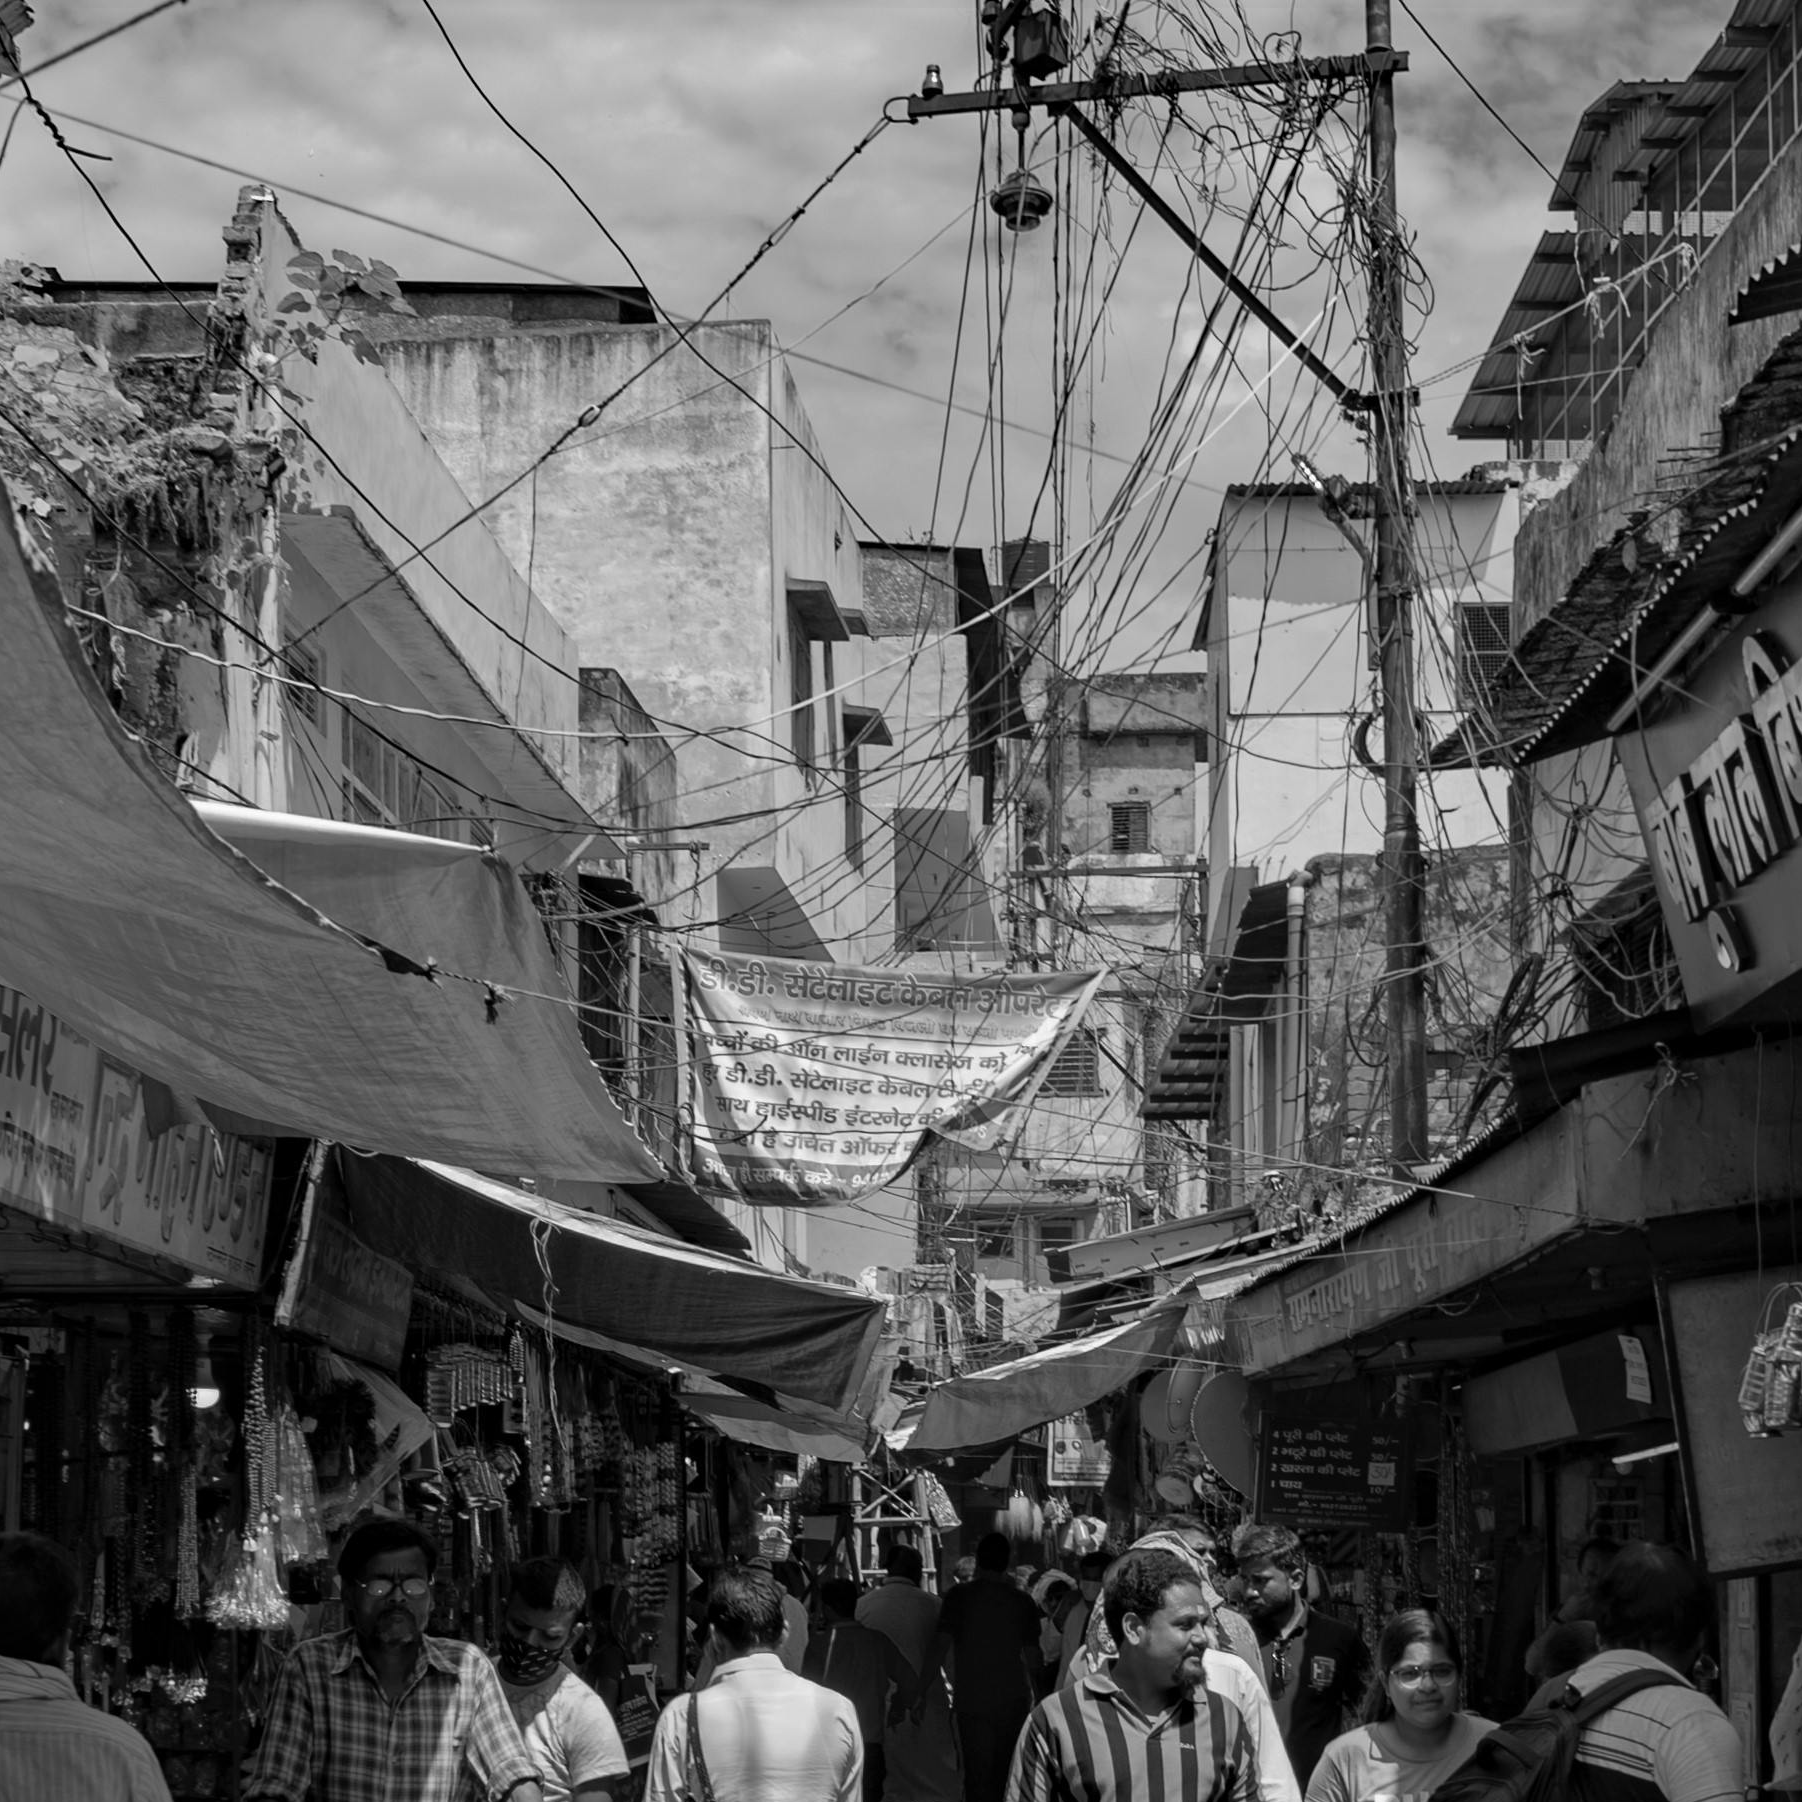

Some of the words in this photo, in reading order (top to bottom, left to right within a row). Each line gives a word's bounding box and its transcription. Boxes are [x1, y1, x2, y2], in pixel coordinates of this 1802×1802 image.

[1689, 715, 1779, 889] लाल
[783, 964, 895, 1007] सेटेलाइट
[900, 972, 973, 1012] केबल
[750, 1033, 779, 1053] की
[833, 1042, 890, 1065] लाईन
[789, 1068, 875, 1096] सेटेलाइट
[877, 1074, 931, 1099] केबल
[755, 1097, 840, 1124] हाईस्पीड
[845, 1104, 916, 1127] इंटरनेट
